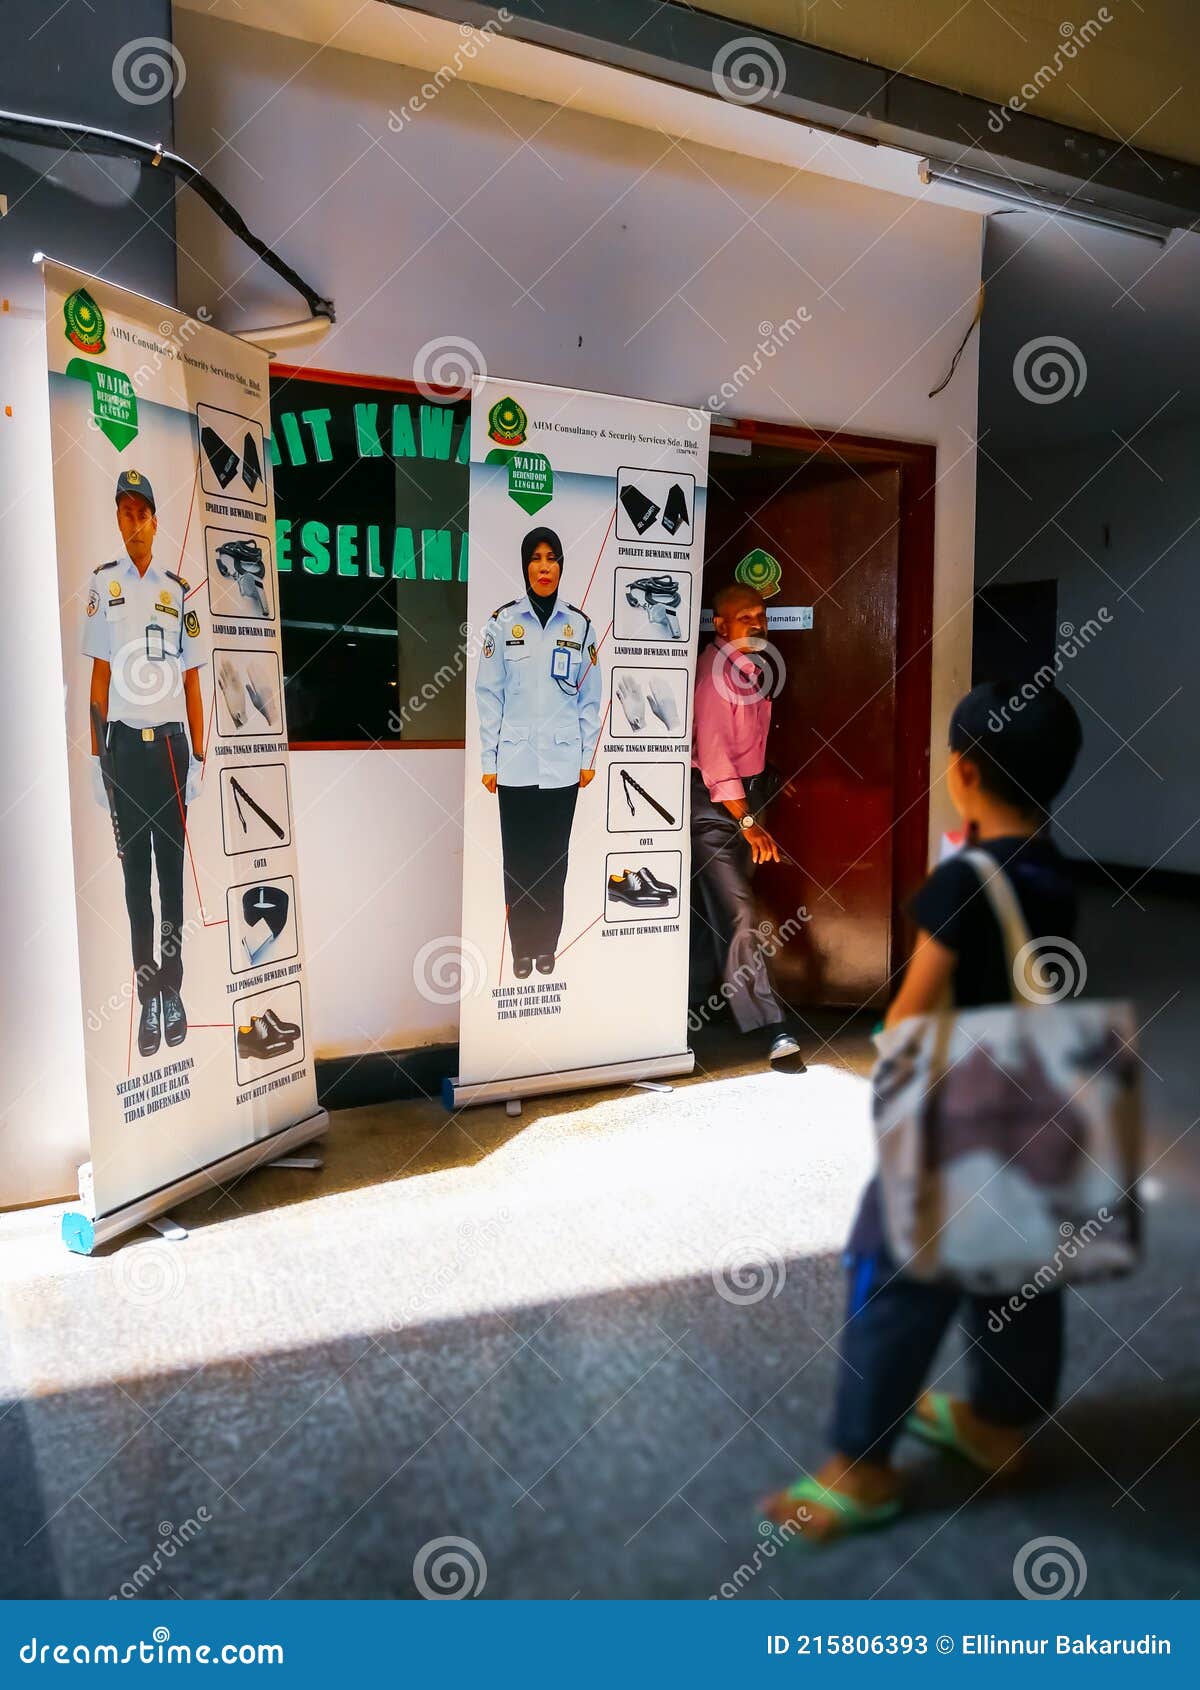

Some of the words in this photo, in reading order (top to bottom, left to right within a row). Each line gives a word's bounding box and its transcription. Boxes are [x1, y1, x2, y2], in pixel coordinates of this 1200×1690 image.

[111, 326, 130, 342] AHM
[97, 372, 130, 396] WAJIB
[532, 421, 552, 431] AHM
[554, 424, 598, 438] Consultancy
[600, 430, 607, 438] &
[608, 431, 636, 443] Security
[638, 434, 666, 445] Services
[514, 456, 546, 471] WAJIB
[515, 480, 545, 490] LENGKAP
[645, 549, 671, 558] BEWARNA
[644, 648, 670, 656] BEWARNA
[626, 744, 645, 752] TANGAN
[647, 744, 673, 752] BEWARNA
[254, 858, 267, 868] COTA
[602, 929, 618, 937] KASUT
[637, 926, 661, 934] BEWARNA
[226, 982, 237, 993] TALI
[239, 974, 263, 990] PINGGANG
[492, 987, 515, 998] SELUAR
[516, 985, 536, 995] SLACK
[538, 982, 567, 992] BEWARNA
[498, 998, 518, 1008] HITAM
[524, 996, 540, 1005] BLUE
[541, 994, 561, 1003] BLACK
[497, 1010, 517, 1020] TIDAK
[116, 1077, 141, 1095] SELUAR
[142, 1069, 162, 1086] SLACK
[164, 1057, 194, 1077] BEWARNA
[123, 1090, 145, 1108] HITAM
[151, 1082, 168, 1097] BLUE
[169, 1074, 190, 1090] BLACK
[124, 1106, 145, 1123] TIDAK
